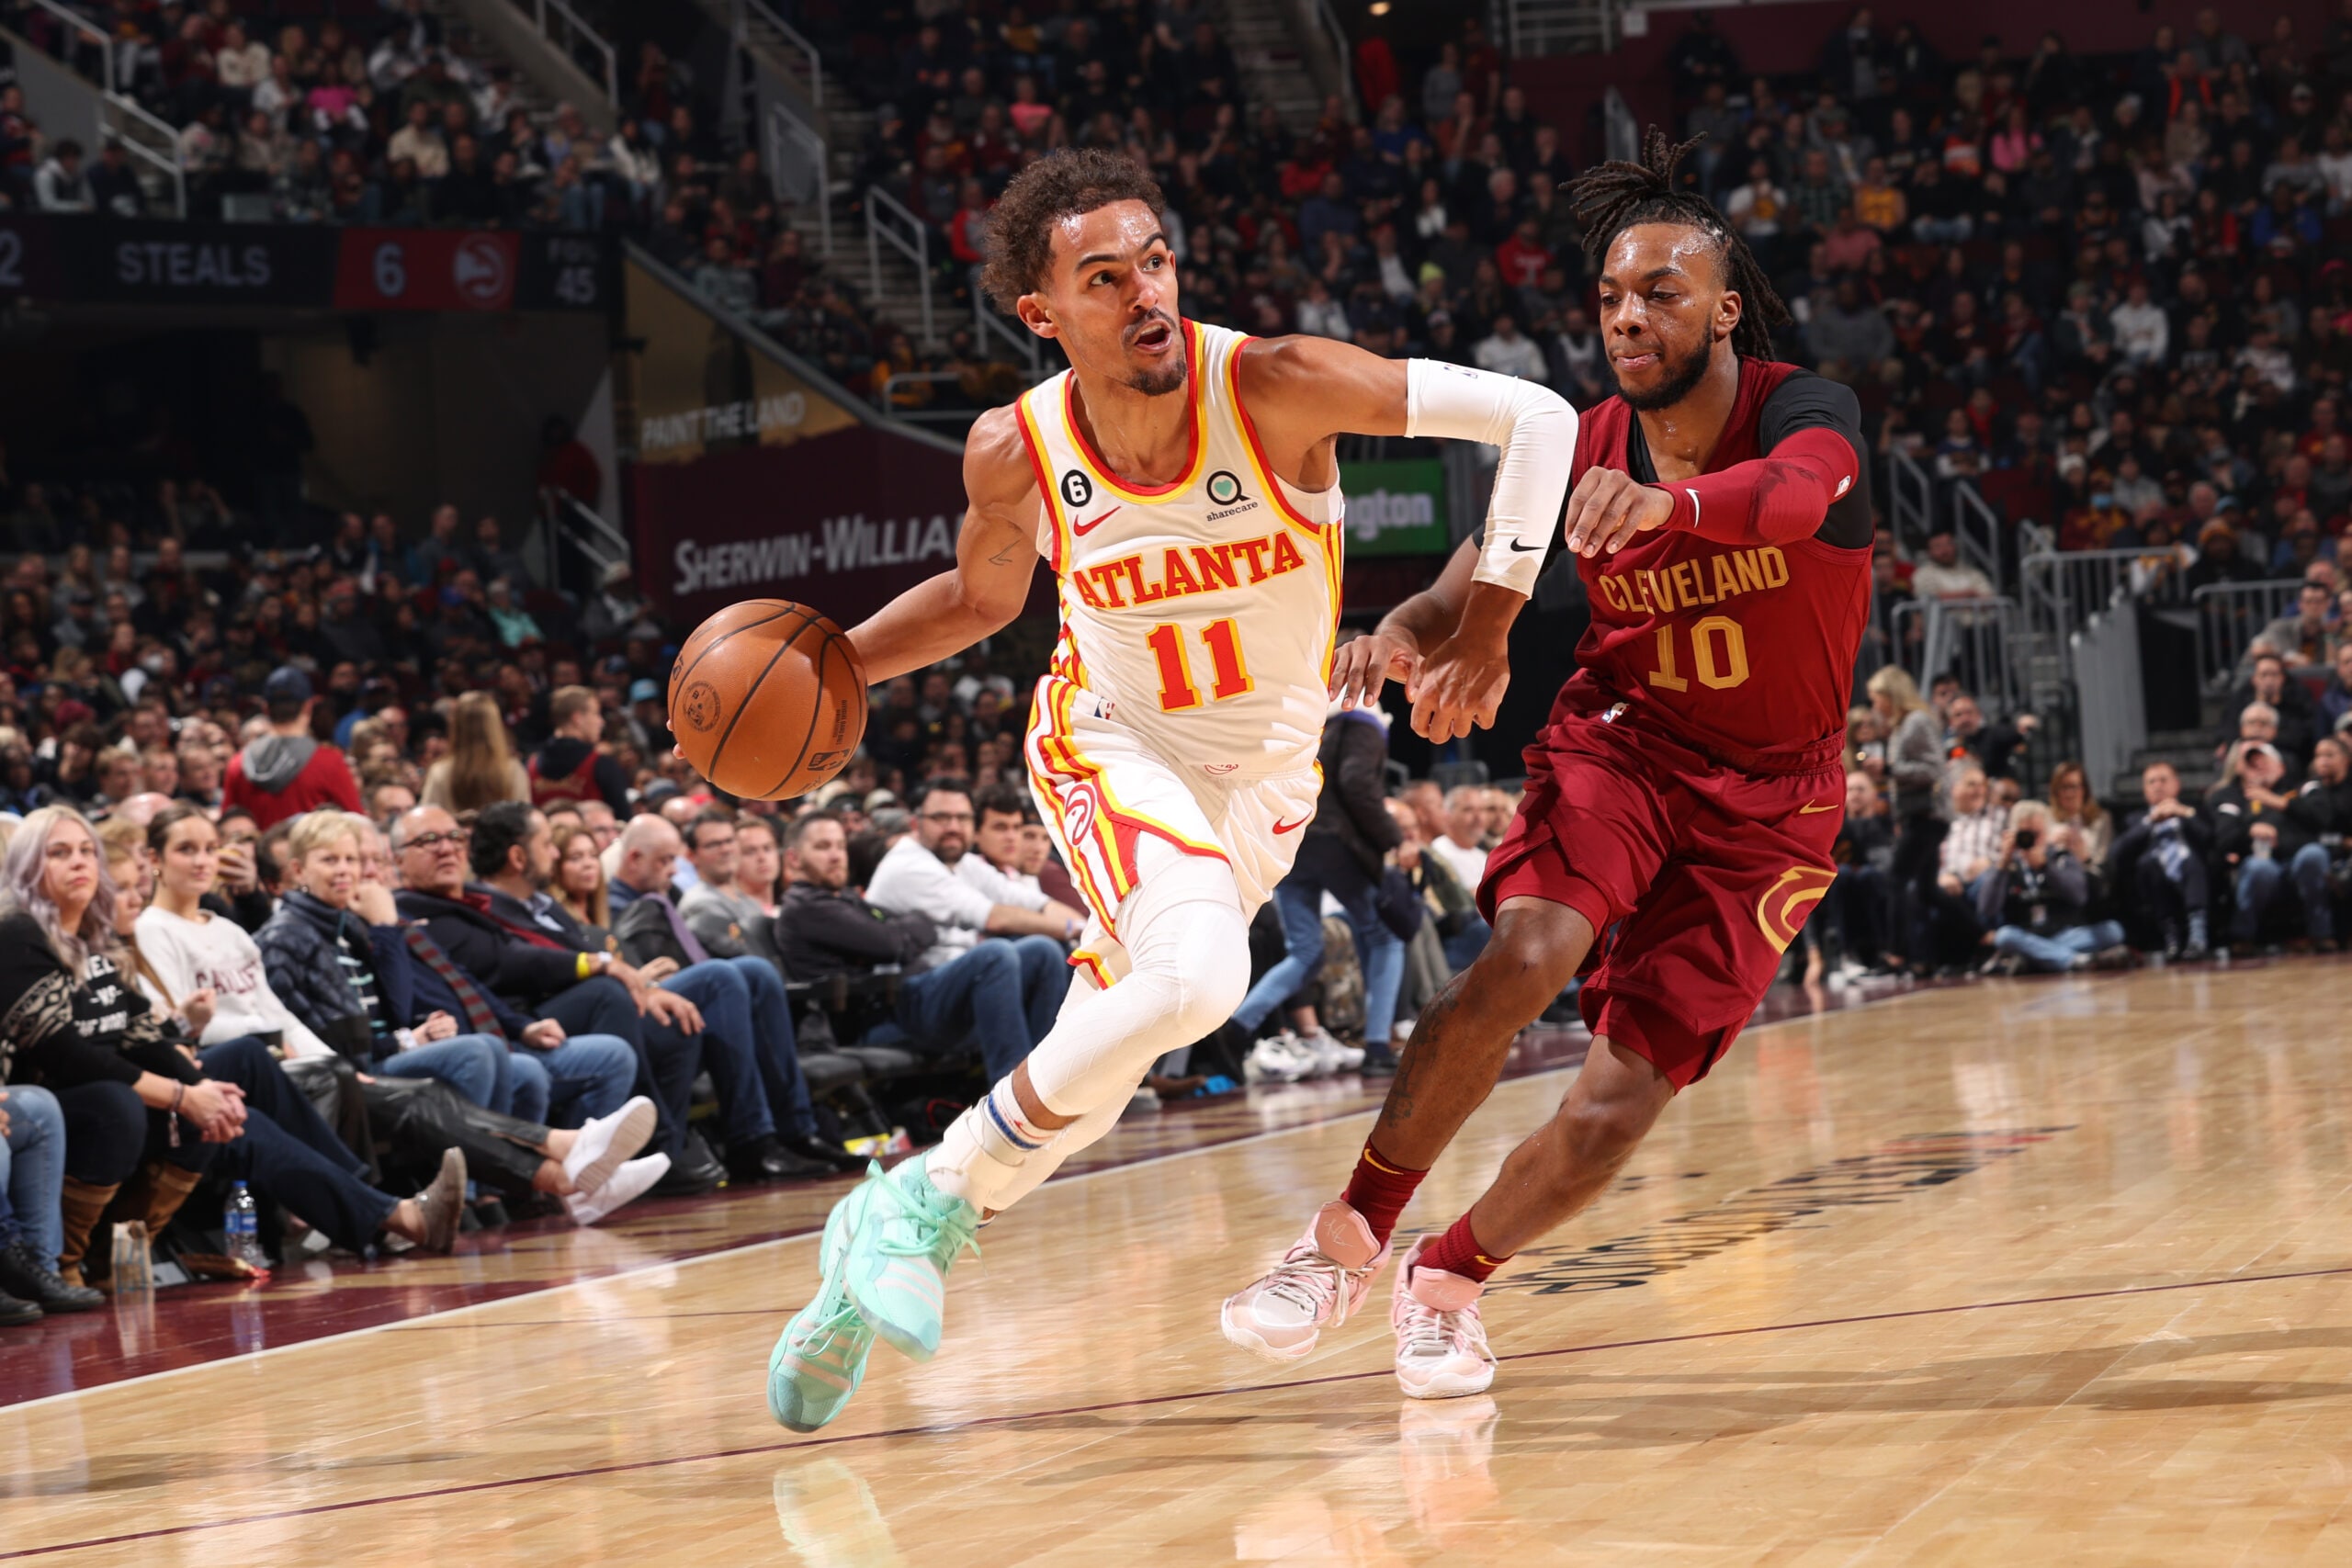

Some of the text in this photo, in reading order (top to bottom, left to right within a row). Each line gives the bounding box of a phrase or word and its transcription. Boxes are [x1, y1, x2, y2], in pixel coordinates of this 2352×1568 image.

[117, 241, 271, 286] STEALS
[373, 243, 406, 297] 6
[554, 265, 596, 304] 45
[640, 391, 806, 449] PAINT THE LAND
[1068, 475, 1088, 503] 6
[1206, 502, 1259, 522] sharecare
[672, 512, 959, 596] SHERWIN-WILLIA
[1072, 529, 1306, 610] ATLANTA
[1599, 547, 1790, 615] CLEVELAND
[1146, 617, 1255, 713] 11
[1649, 615, 1749, 693] 10
